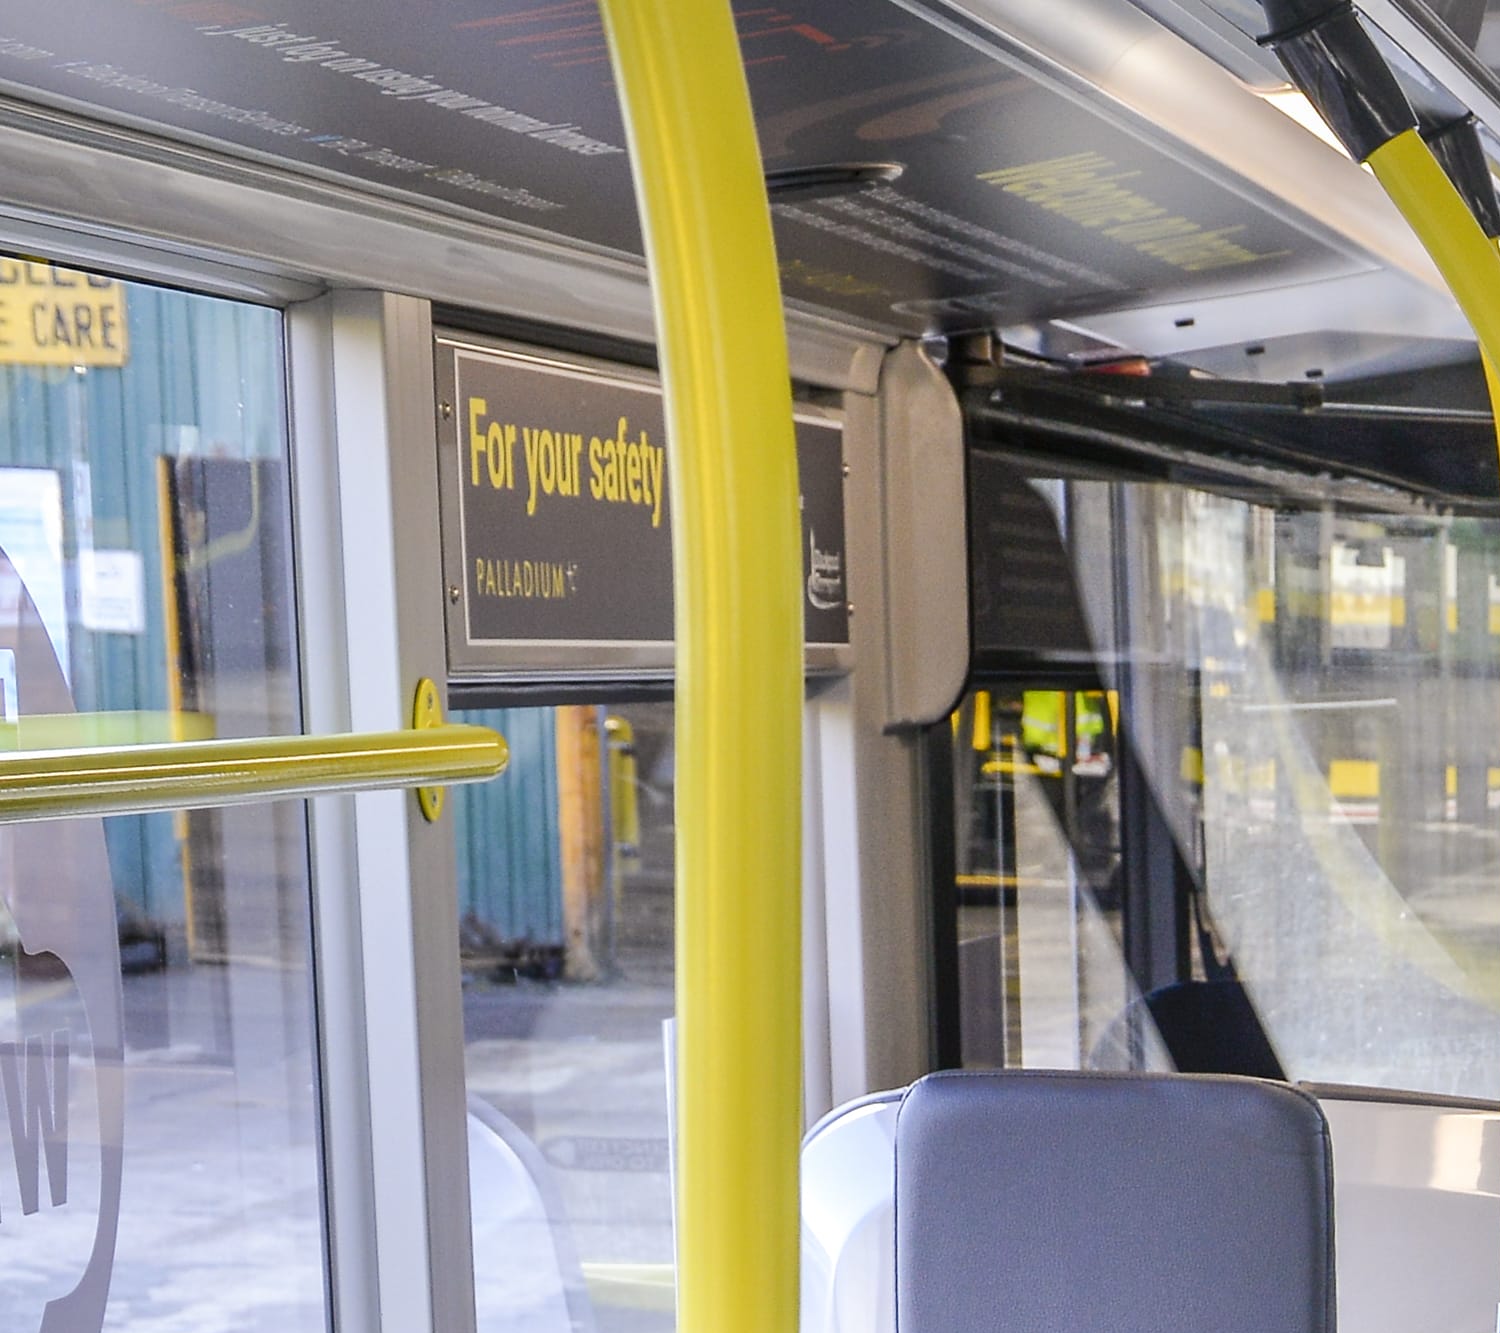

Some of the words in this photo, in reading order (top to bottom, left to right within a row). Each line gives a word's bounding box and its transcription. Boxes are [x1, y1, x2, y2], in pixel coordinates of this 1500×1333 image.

[31, 301, 117, 350] CARE
[468, 396, 518, 491] For
[522, 423, 584, 518] your
[588, 415, 666, 529] safety
[475, 556, 567, 600] PALLADIUM
